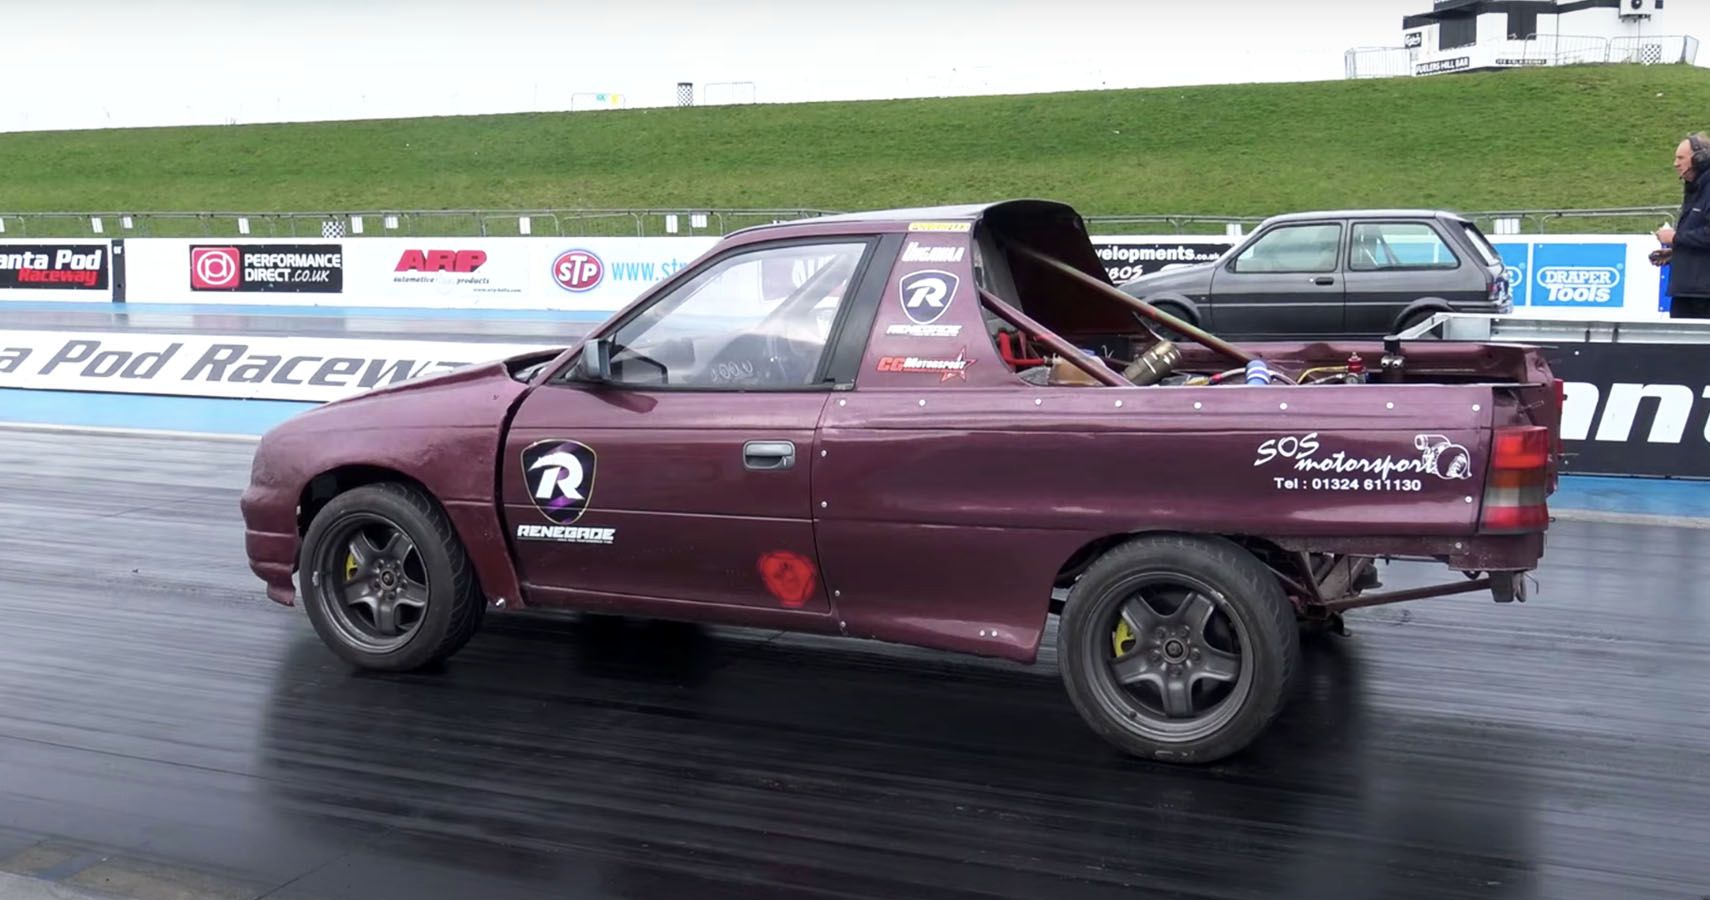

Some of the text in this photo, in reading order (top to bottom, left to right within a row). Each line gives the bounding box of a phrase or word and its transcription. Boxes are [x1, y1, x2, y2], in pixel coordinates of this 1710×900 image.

[1456, 57, 1469, 68] BAR
[55, 249, 102, 270] Pod
[244, 253, 341, 268] PERFORMANCE
[394, 249, 487, 272] ARP
[18, 267, 98, 287] Raceway
[559, 255, 598, 286] STP
[1545, 270, 1611, 284] DRAPER
[457, 277, 490, 285] products
[1548, 284, 1611, 302] Tools
[38, 340, 184, 379] Pod
[877, 357, 905, 371] CG
[1254, 432, 1320, 466] SOS
[1294, 450, 1438, 481] motorsport
[1312, 478, 1359, 490] 01324
[1363, 479, 1422, 491] 611130
[517, 525, 616, 541] RENEGADE
